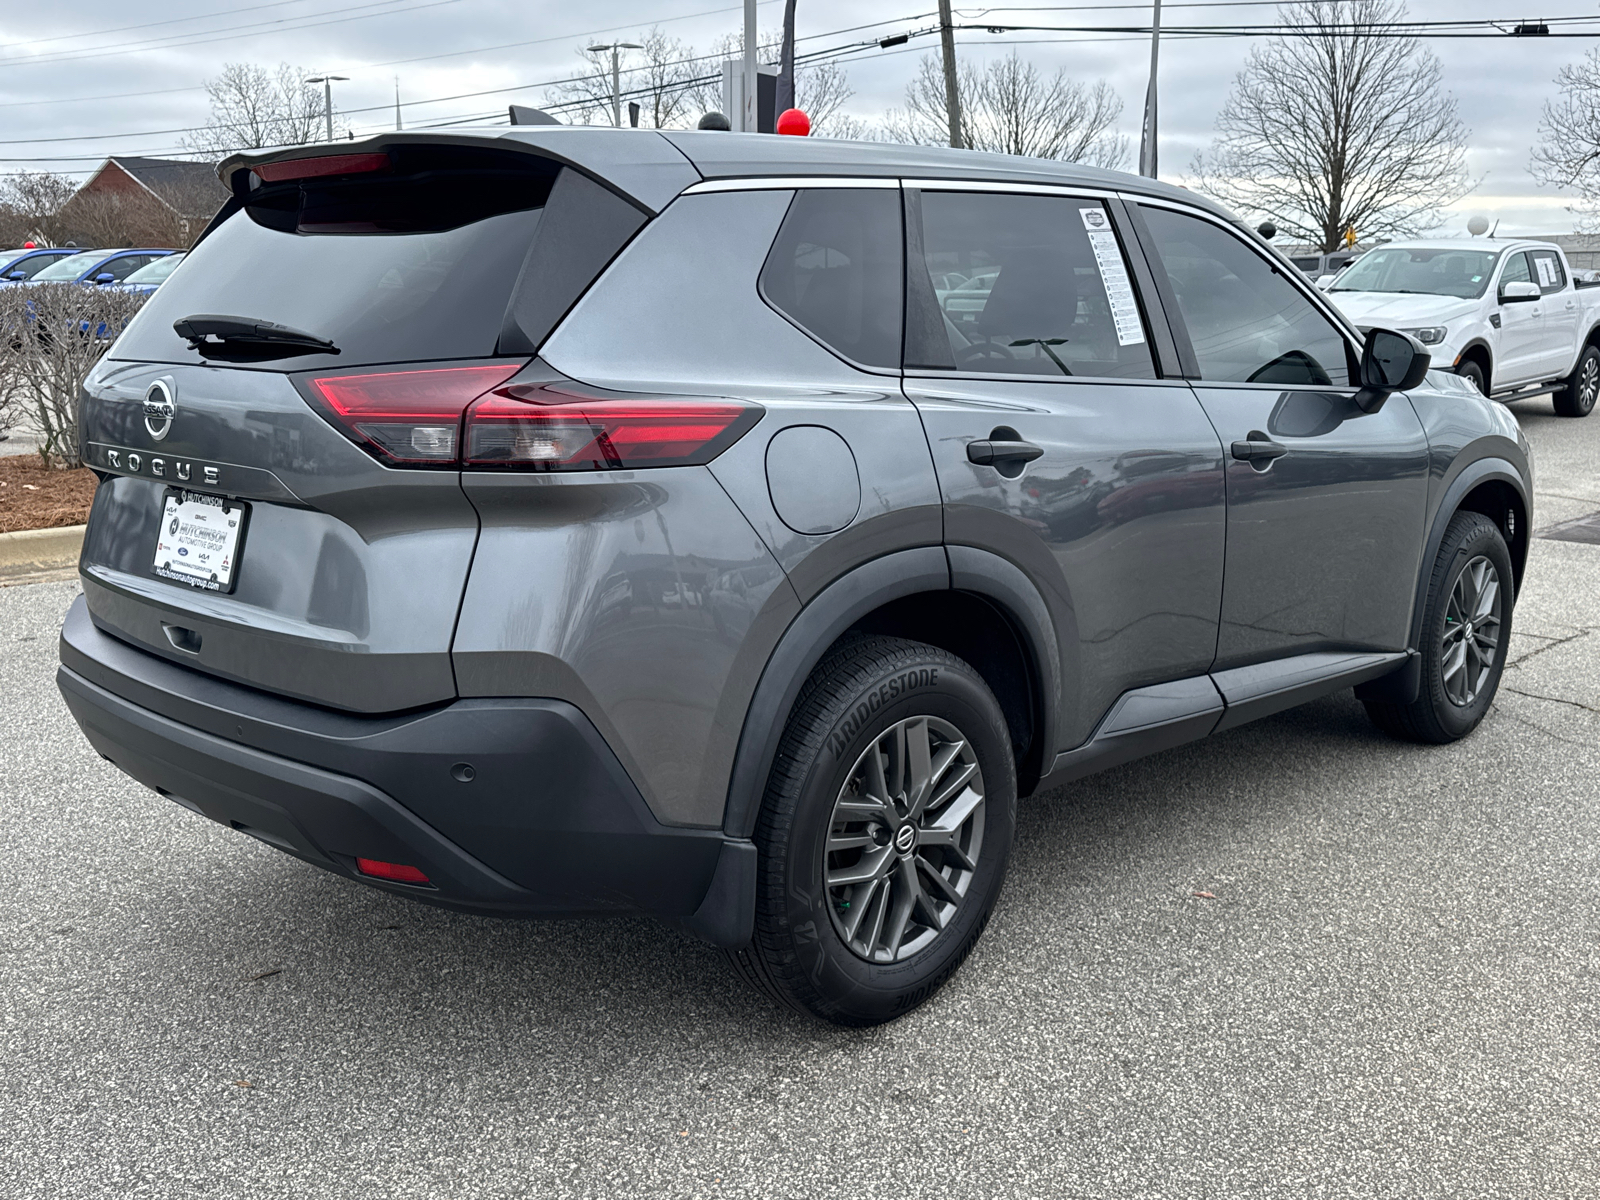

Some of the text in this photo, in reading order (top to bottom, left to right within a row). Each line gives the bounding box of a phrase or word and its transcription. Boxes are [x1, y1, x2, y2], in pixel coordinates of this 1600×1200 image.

[108, 449, 220, 485] ROGUE
[187, 492, 224, 508] HUTCHINSON
[178, 537, 207, 549] AUTOMOTIVE
[207, 541, 223, 551] GROUP
[179, 522, 228, 544] HUTCHINSON
[826, 668, 938, 762] BRIDGESTONE
